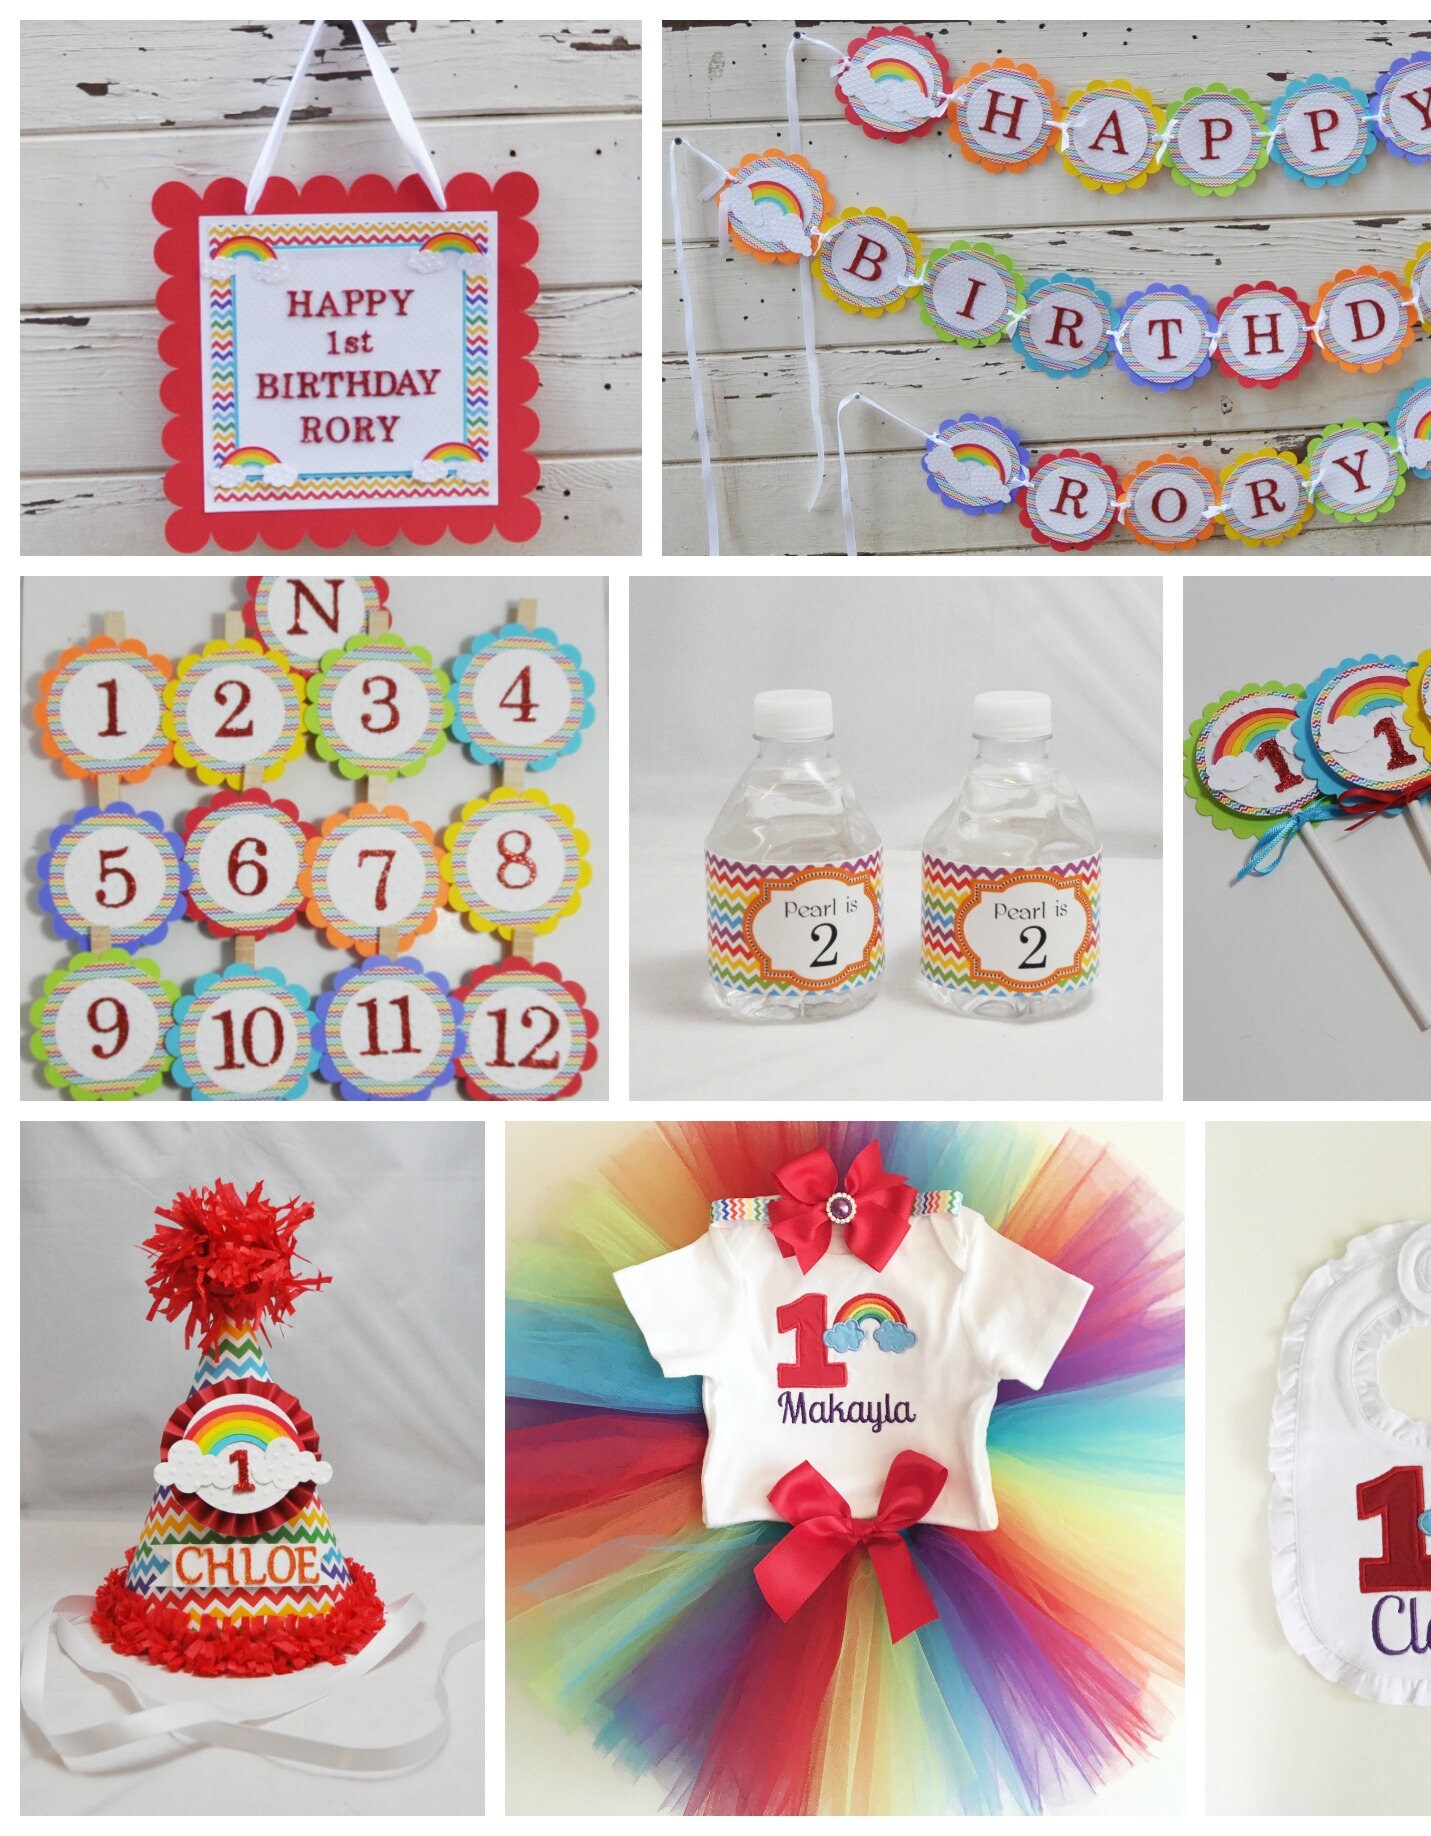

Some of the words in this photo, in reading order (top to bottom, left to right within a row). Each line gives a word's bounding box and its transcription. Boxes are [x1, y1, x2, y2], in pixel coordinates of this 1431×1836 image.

[287, 289, 415, 318] HAPPY
[327, 330, 374, 356] 1st
[256, 368, 441, 400] BIRTHDAY
[300, 415, 401, 444] RORY
[1049, 449, 1370, 524] RORY
[285, 578, 345, 636] N
[97, 679, 127, 737] 1
[213, 680, 254, 738] 2
[360, 676, 400, 734] 3
[500, 665, 539, 722] 4
[1255, 737, 1304, 794] 1
[1372, 716, 1417, 771] 1
[95, 846, 137, 908] 5
[227, 837, 268, 896] 6
[357, 849, 396, 910] 7
[496, 829, 537, 890] 8
[784, 899, 836, 919] Pearl
[845, 897, 858, 913] is
[993, 901, 1046, 921] Pearl
[1055, 899, 1068, 916] is
[809, 922, 839, 968] 2
[1018, 925, 1047, 970] 2
[87, 996, 130, 1058] 9
[212, 1005, 284, 1071] 10
[357, 995, 421, 1056] 11
[486, 1004, 560, 1070] 12
[776, 1292, 848, 1389] 1
[777, 1390, 917, 1433] Makayla
[229, 1449, 255, 1494] 1
[175, 1545, 321, 1586] CHLOE
